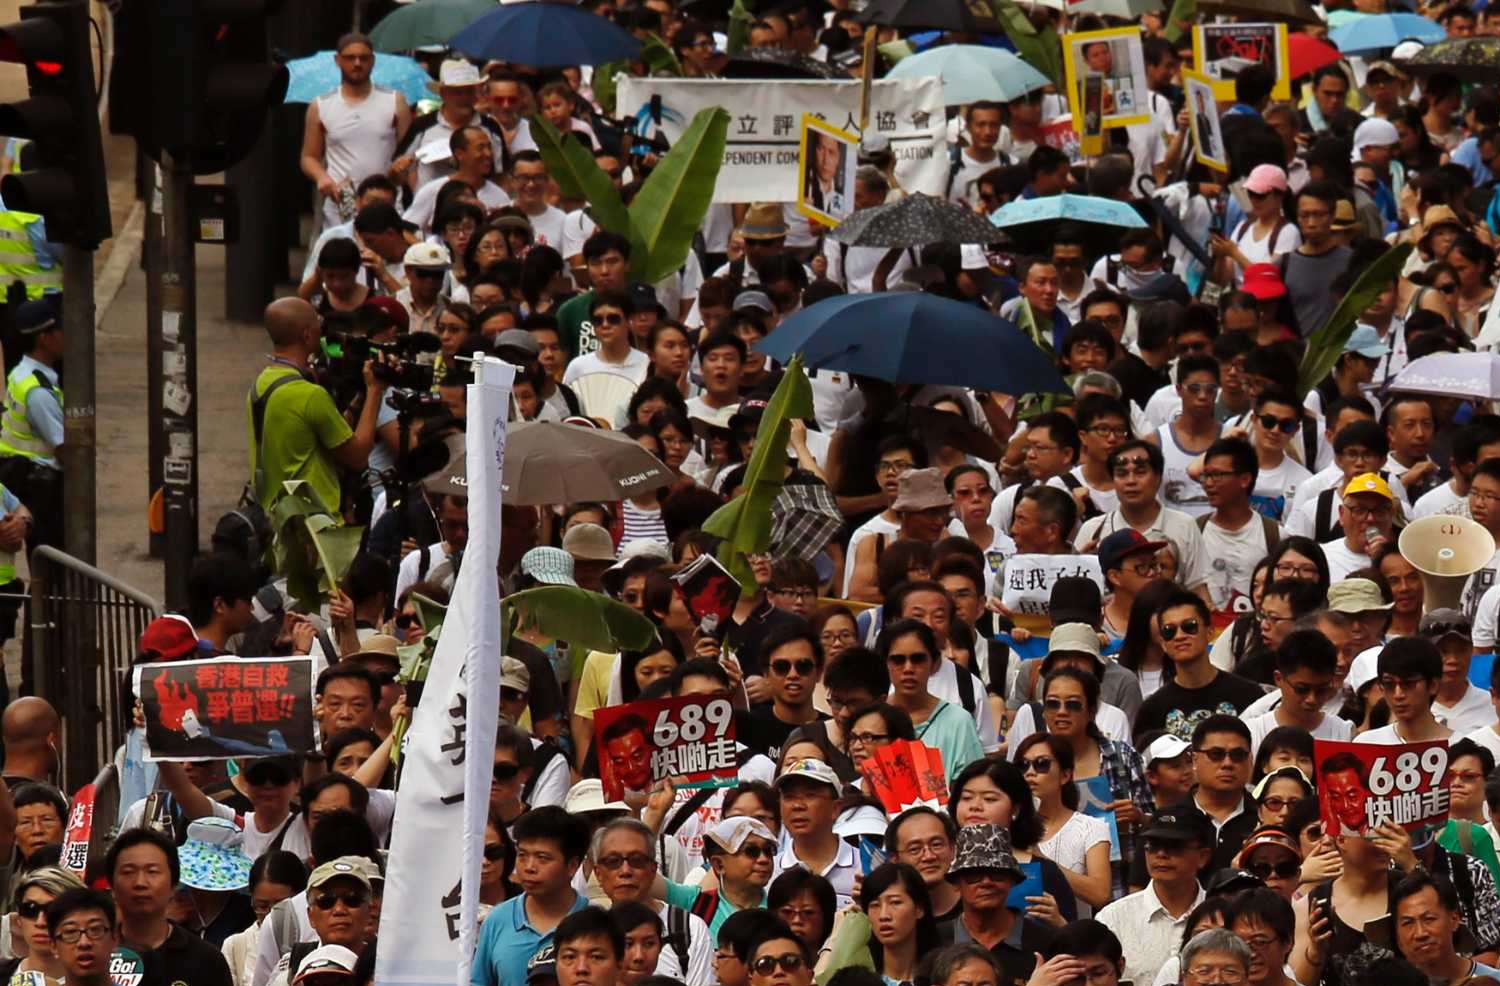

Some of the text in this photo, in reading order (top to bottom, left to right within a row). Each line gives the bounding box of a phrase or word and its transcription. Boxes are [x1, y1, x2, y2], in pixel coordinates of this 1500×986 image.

[738, 110, 932, 136] 立評人協會
[721, 150, 772, 165] EPENDENT
[619, 473, 647, 487] KUONI
[195, 663, 290, 689] 香港自救
[653, 699, 733, 747] 689
[1368, 746, 1449, 796] 689
[109, 957, 135, 973] Go!
